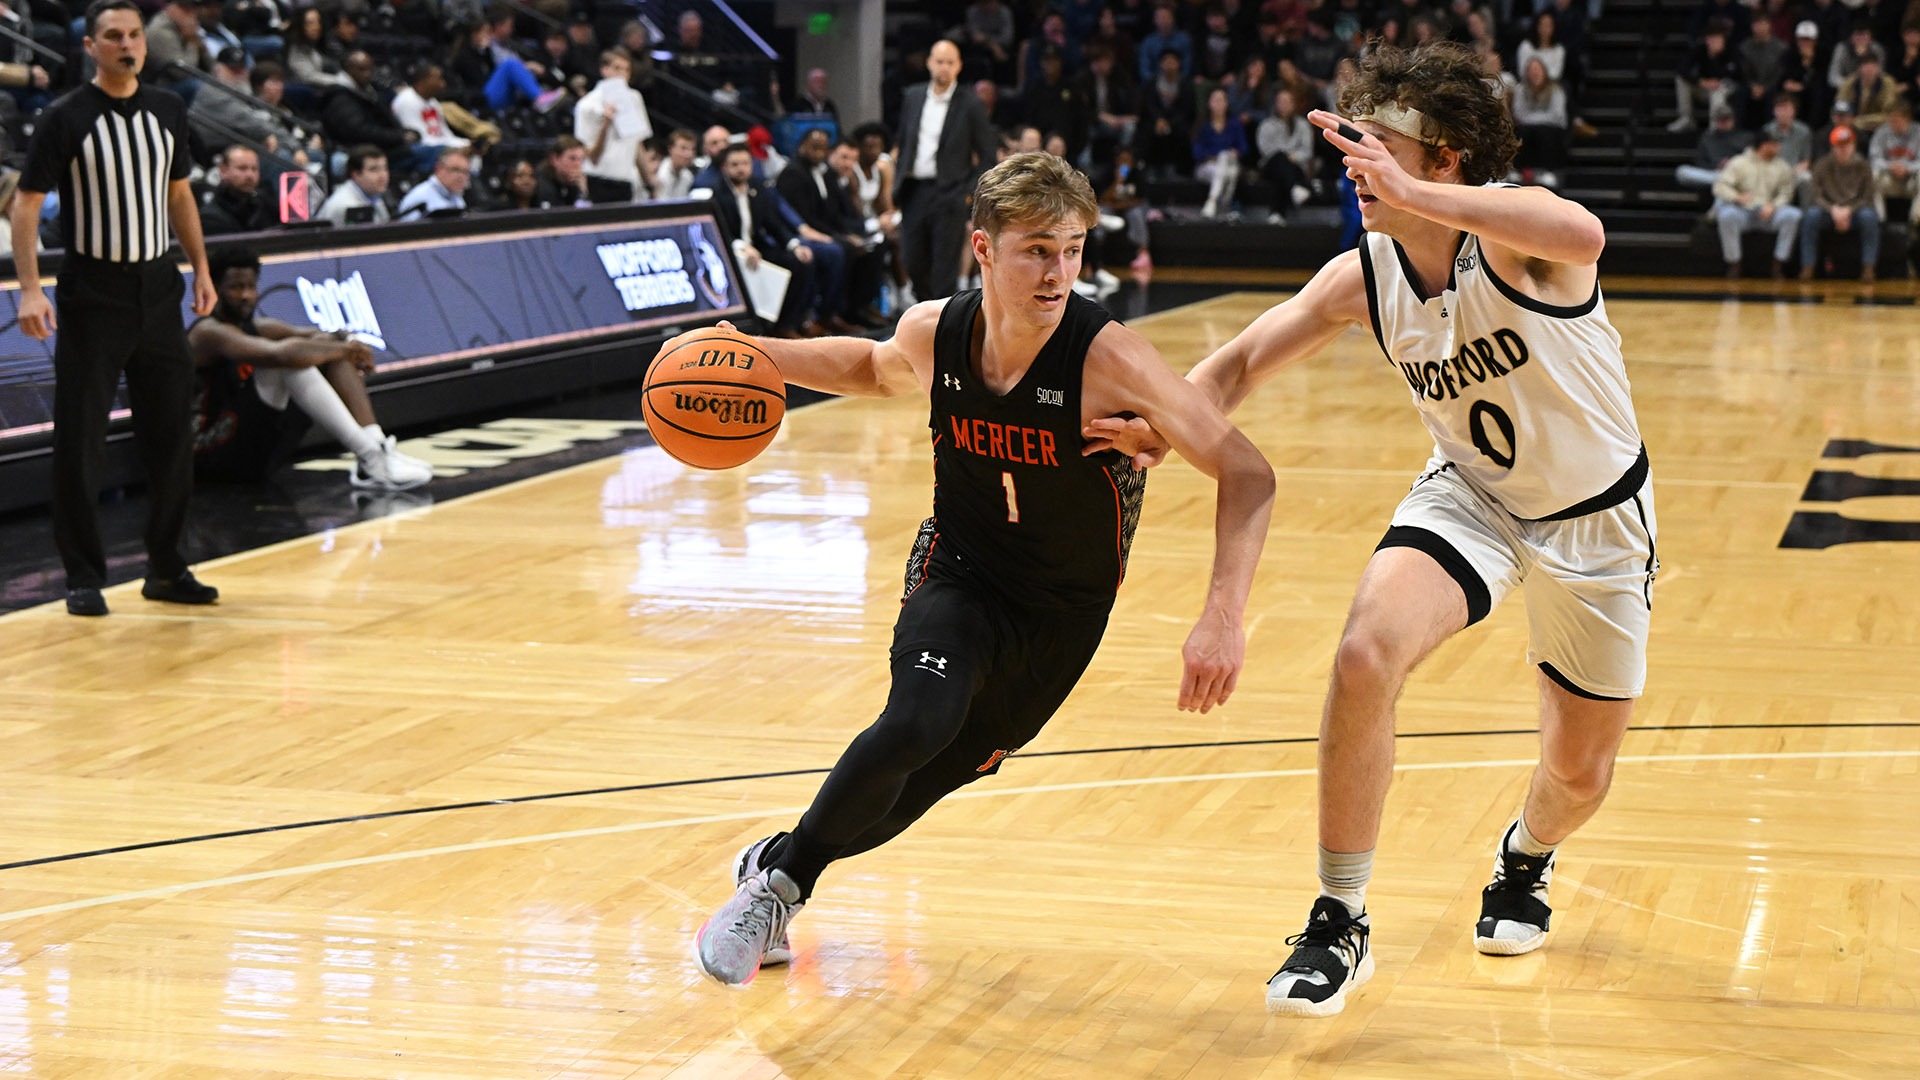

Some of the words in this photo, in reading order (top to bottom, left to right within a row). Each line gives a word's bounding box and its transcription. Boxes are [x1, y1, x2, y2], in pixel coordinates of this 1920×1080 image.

[596, 238, 683, 278] WOFFORD
[1456, 254, 1477, 272] SOC
[614, 269, 696, 311] TERRIERS
[698, 350, 755, 371] EVO
[1399, 327, 1529, 401] WOFFORD
[675, 393, 768, 425] Wilson
[951, 415, 1060, 467] MERCER
[1469, 400, 1516, 470] 0
[1002, 471, 1020, 524] 1
